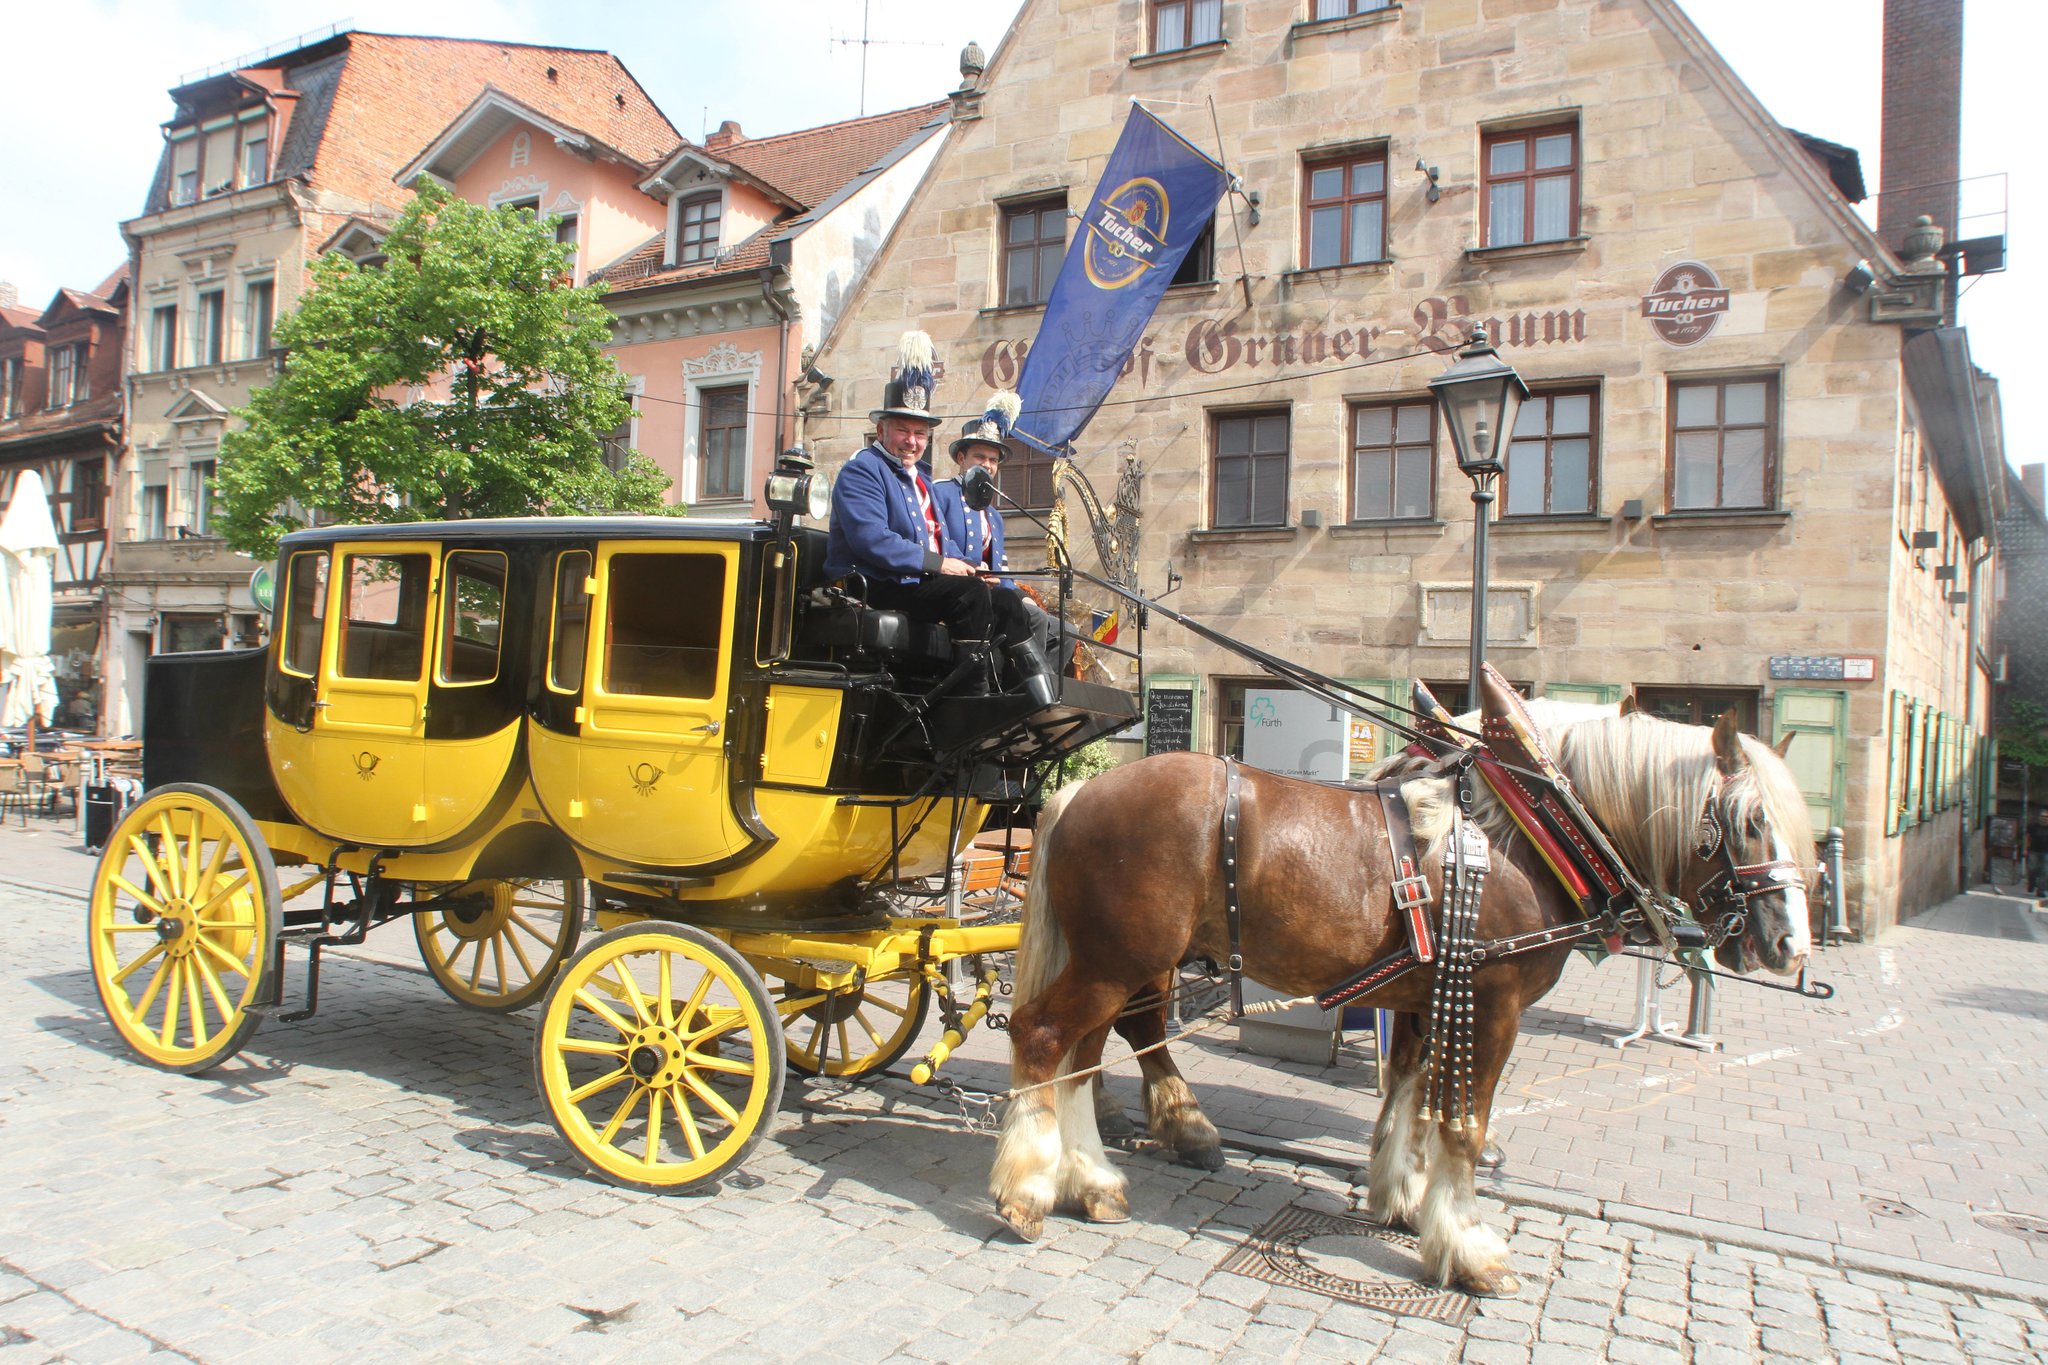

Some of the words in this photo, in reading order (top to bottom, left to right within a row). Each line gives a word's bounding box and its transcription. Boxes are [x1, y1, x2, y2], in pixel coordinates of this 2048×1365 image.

[1098, 210, 1154, 255] Tucher
[1648, 296, 1725, 313] Tucher
[1413, 294, 1589, 355] Baum
[1261, 717, 1282, 727] Fürth
[1351, 725, 1373, 739] JA
